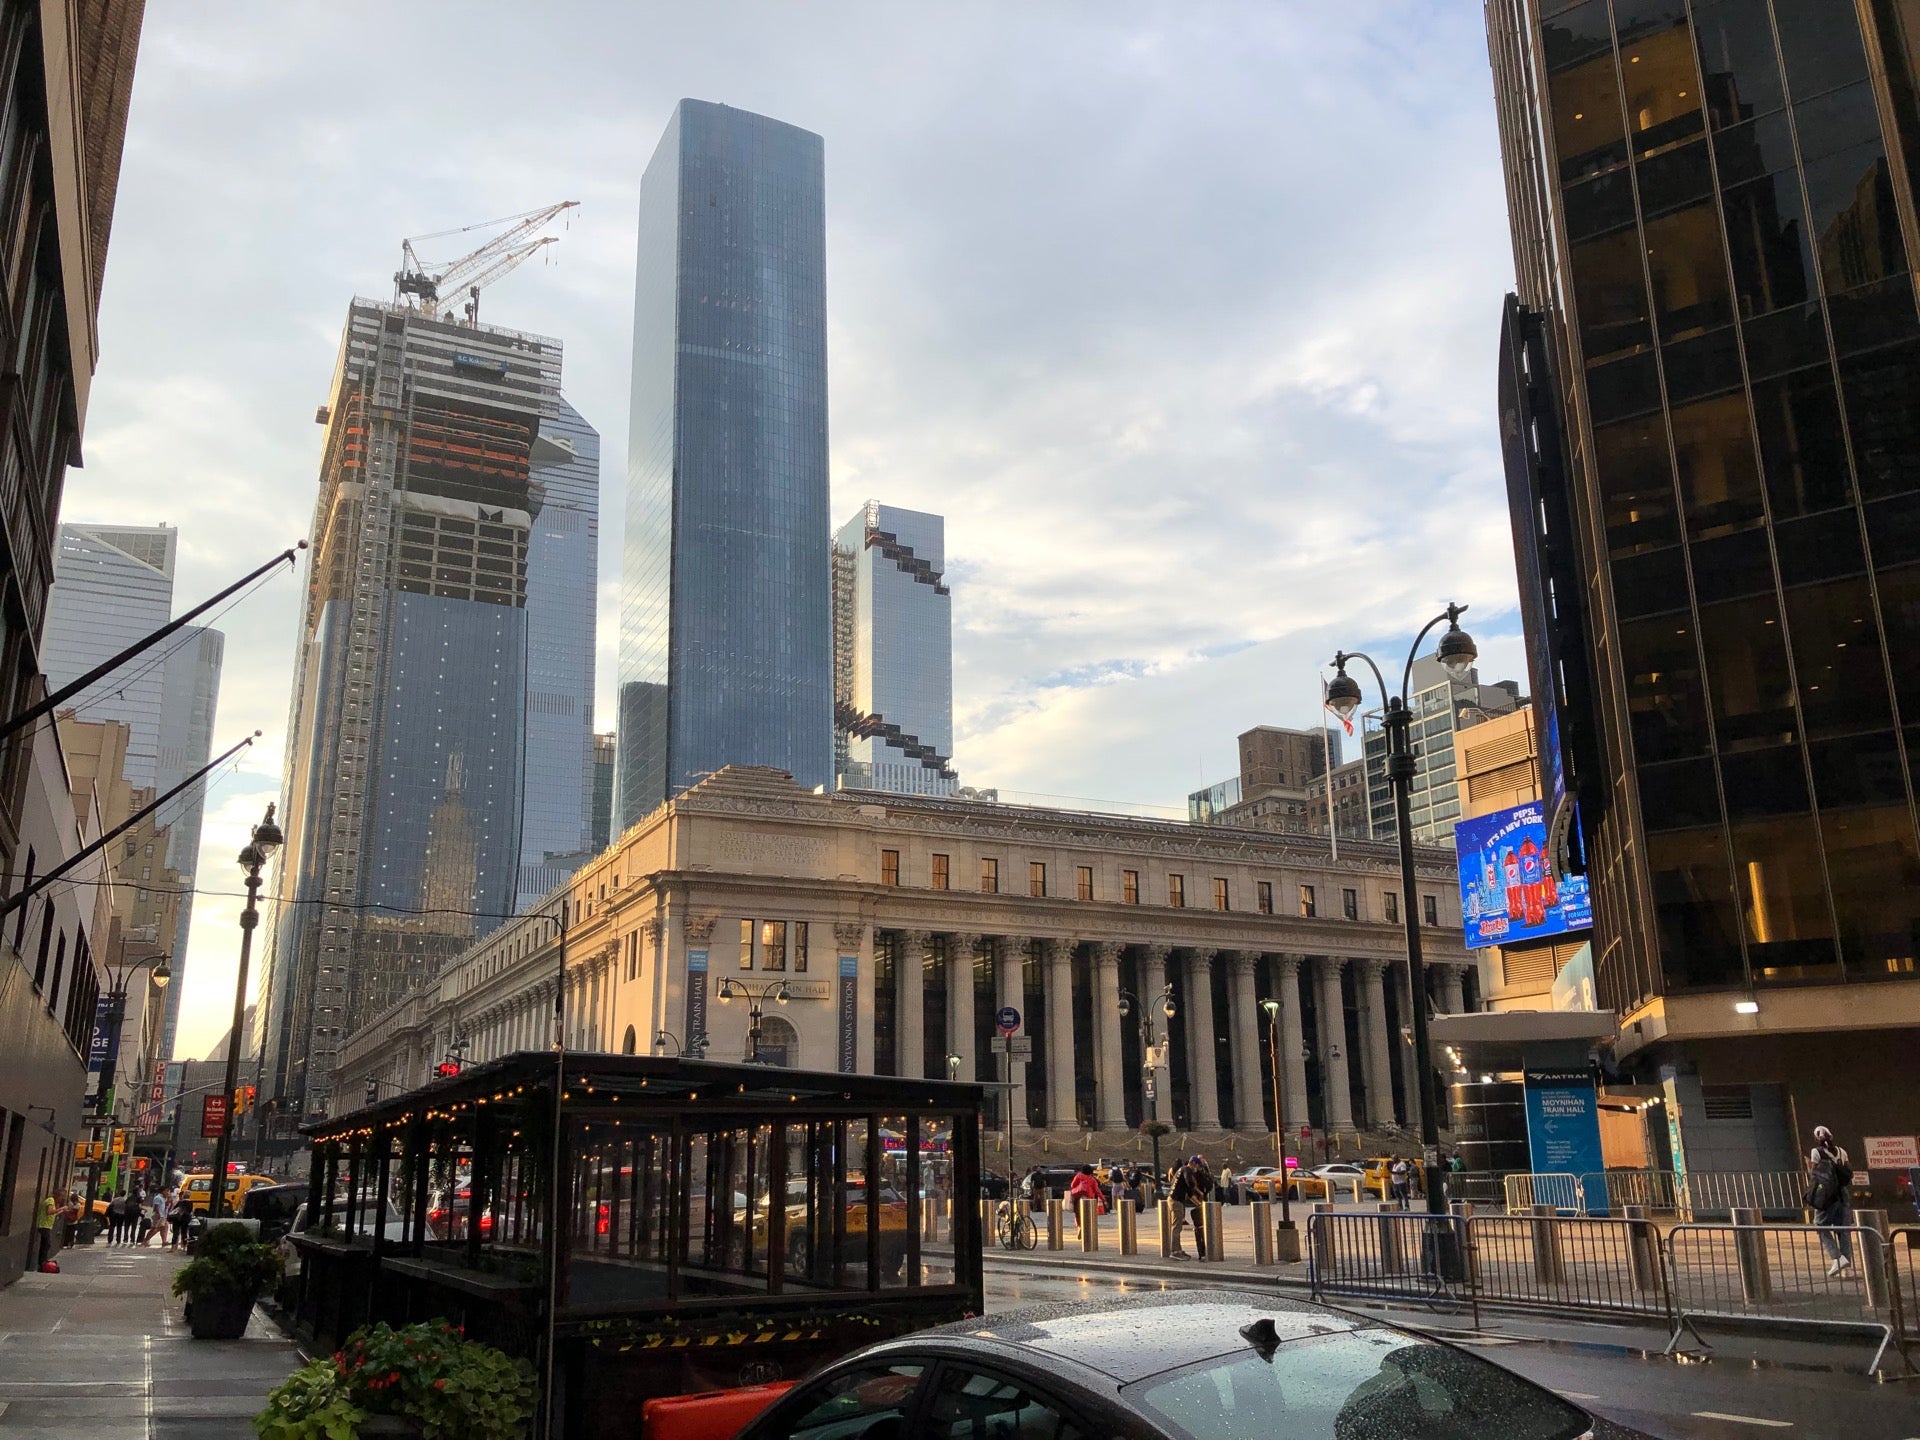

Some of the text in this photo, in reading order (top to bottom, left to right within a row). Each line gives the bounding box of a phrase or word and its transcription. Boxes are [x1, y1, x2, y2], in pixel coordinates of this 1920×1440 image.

[1500, 828, 1506, 837] A
[1505, 819, 1521, 833] NEW
[1521, 815, 1543, 825] YORK
[694, 976, 703, 999] HALL
[775, 984, 802, 993] TAIN
[805, 985, 827, 994] HALL
[845, 981, 854, 1020] STATION
[692, 1003, 702, 1032] TRAIN
